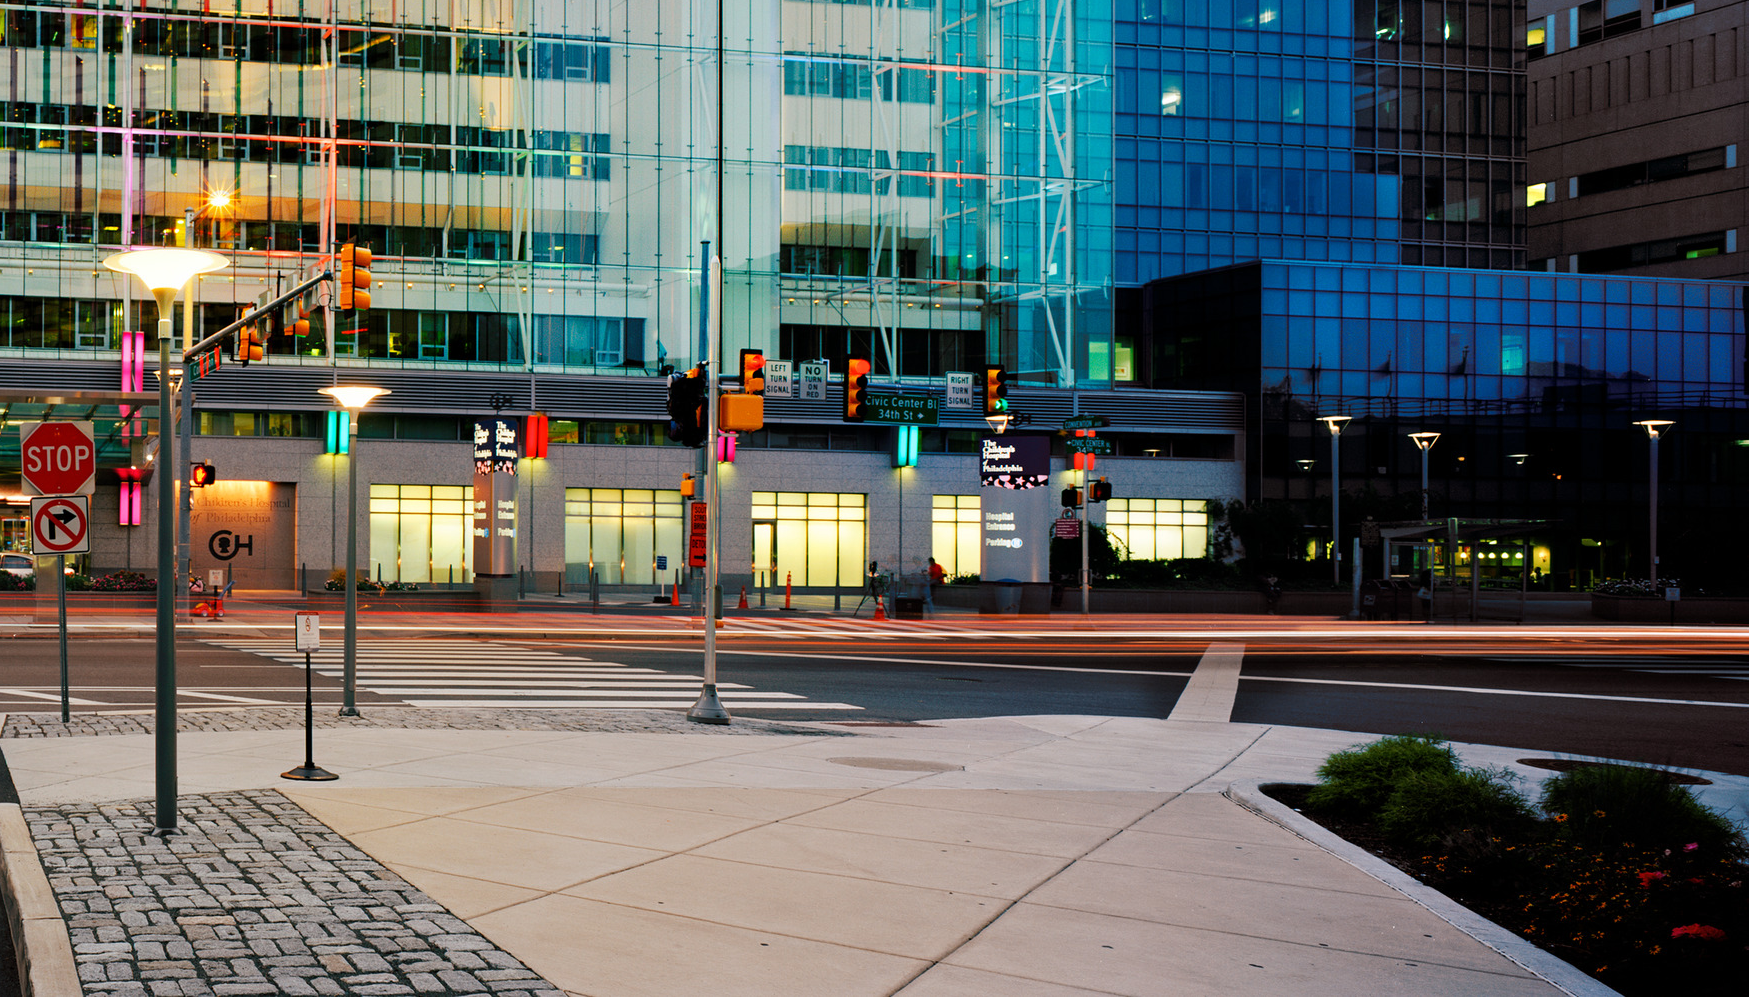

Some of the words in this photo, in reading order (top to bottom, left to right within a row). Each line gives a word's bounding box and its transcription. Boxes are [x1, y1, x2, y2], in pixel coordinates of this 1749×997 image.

[771, 364, 786, 372] LEFT
[805, 366, 821, 375] NO
[951, 376, 969, 384] RIGHT
[767, 385, 790, 393] SIGNAL
[865, 396, 889, 406] Civic
[891, 397, 924, 408] Center
[948, 397, 971, 405] SIGNAL
[878, 409, 900, 419] 34th
[903, 410, 913, 420] St
[1064, 420, 1092, 429] CONVENTION
[982, 439, 997, 447] The
[1071, 439, 1084, 447] CIVIC
[27, 445, 89, 472] STOP
[983, 464, 1023, 474] Philadelphia
[196, 497, 247, 507] Children's
[250, 498, 290, 511] Hospital
[694, 506, 707, 514] SOUT
[189, 513, 202, 524] of
[206, 513, 271, 524] Philadelphia
[985, 512, 1014, 522] Hospital
[985, 522, 1016, 531] Entrance
[985, 537, 1012, 548] Parking
